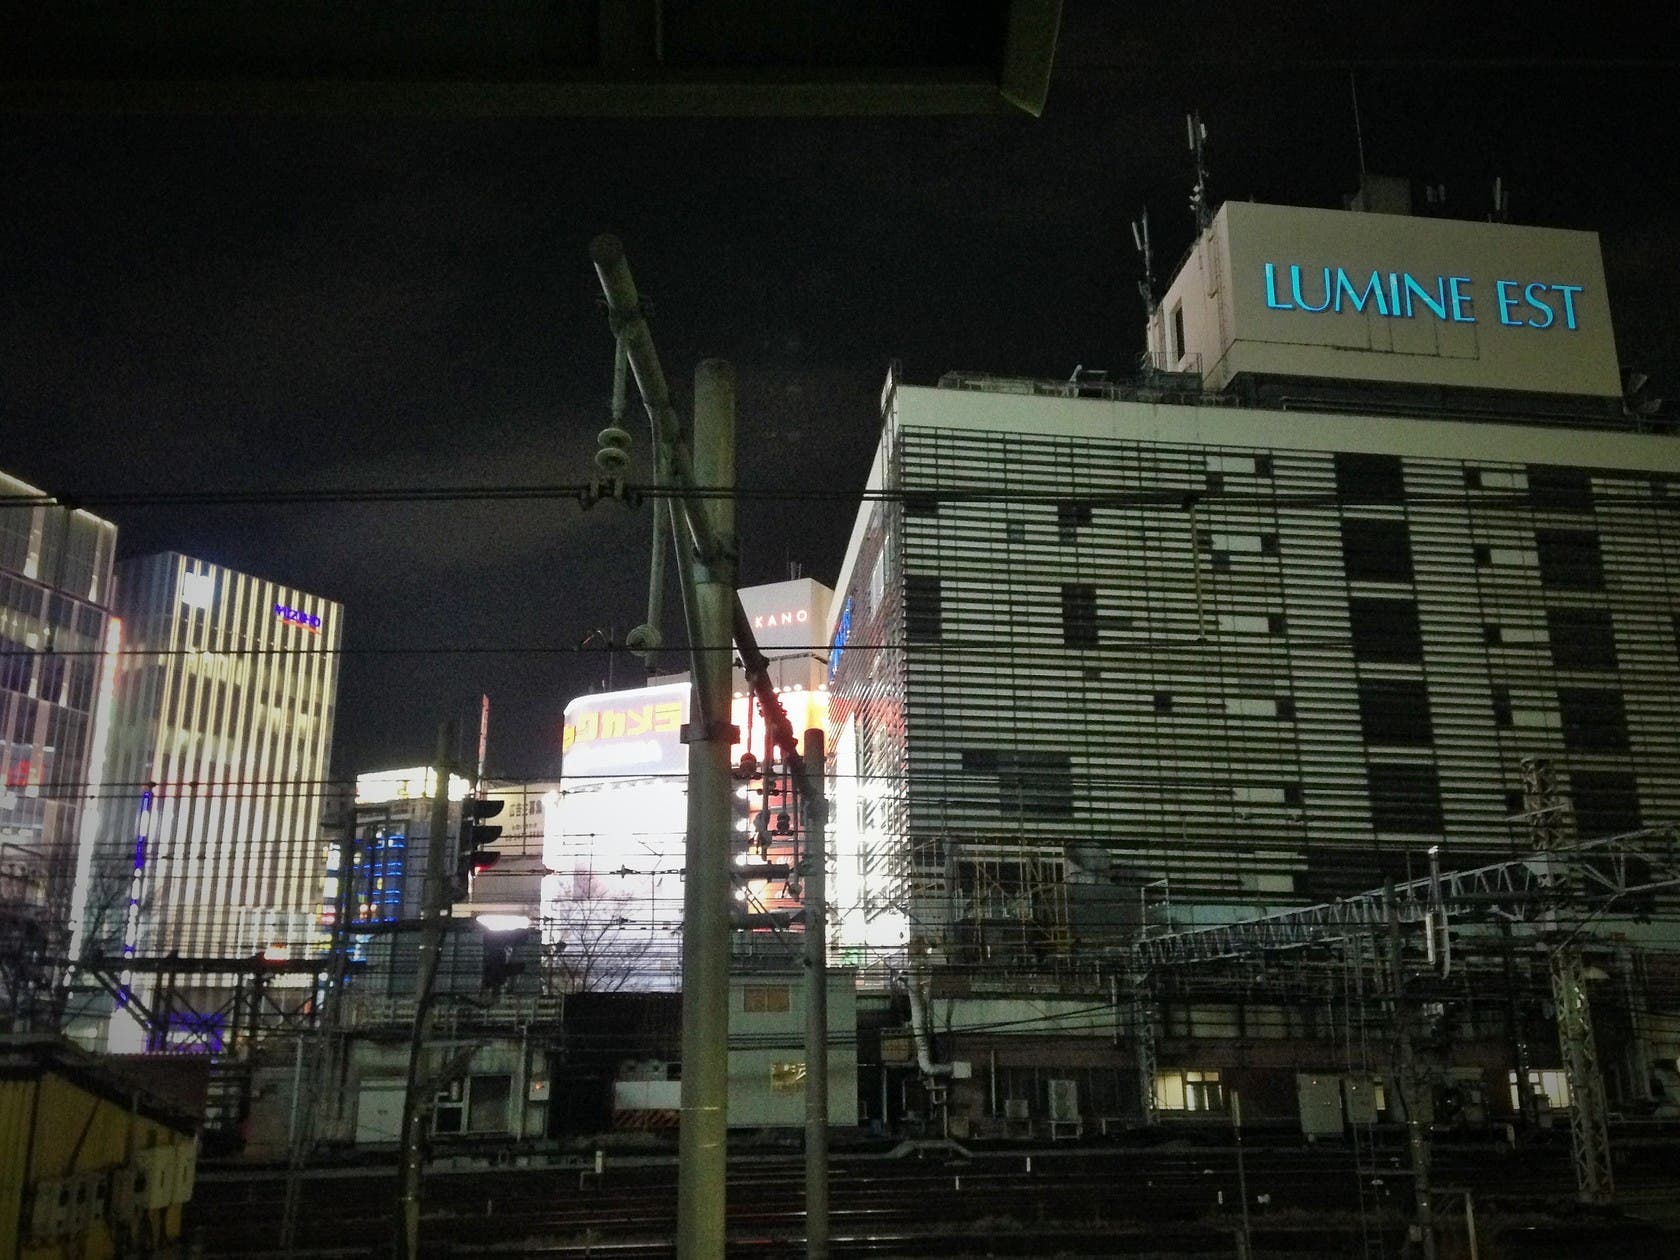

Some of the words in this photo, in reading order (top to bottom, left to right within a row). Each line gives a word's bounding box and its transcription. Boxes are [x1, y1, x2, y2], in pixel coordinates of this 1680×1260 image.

[1264, 262, 1477, 323] LUMINE
[1496, 279, 1584, 330] EST
[754, 609, 808, 628] KANO
